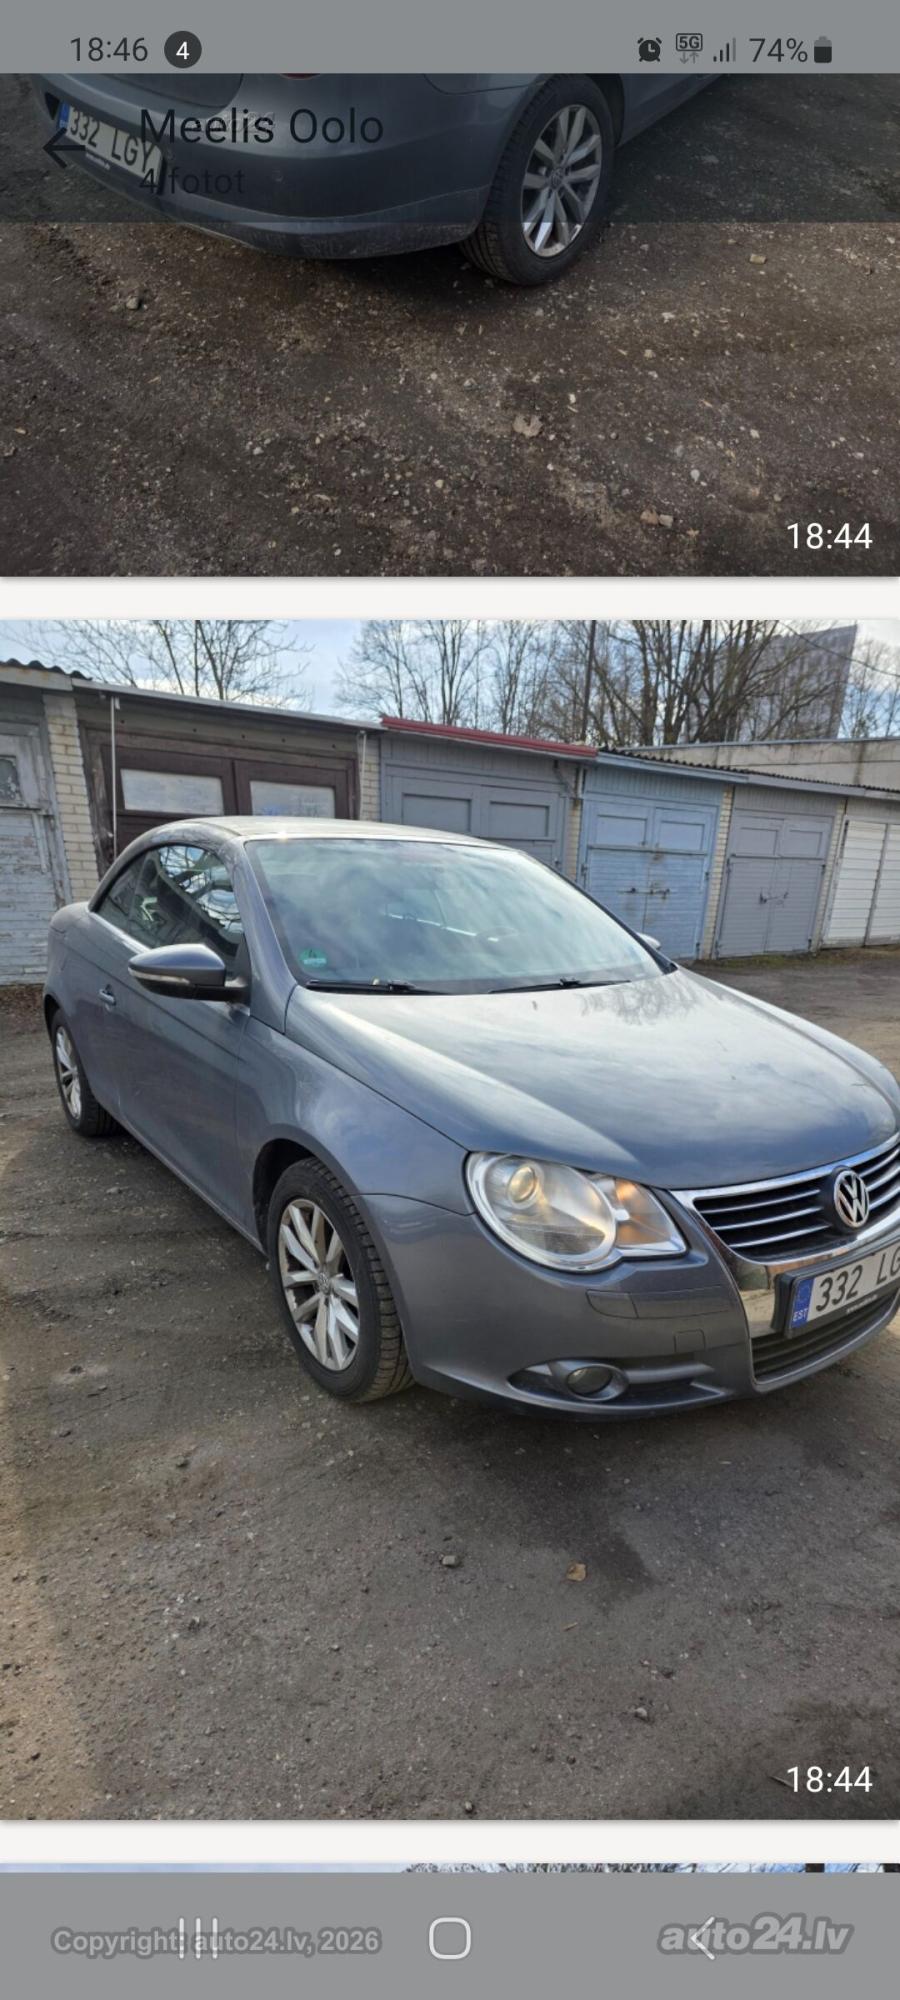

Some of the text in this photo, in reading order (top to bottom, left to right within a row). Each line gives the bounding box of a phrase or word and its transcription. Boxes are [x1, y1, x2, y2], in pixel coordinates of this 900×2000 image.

[71, 37, 148, 62] 18:46
[176, 42, 190, 60] 4
[679, 36, 700, 50] 5G
[749, 38, 808, 63] 74%
[70, 105, 100, 148] 332
[111, 128, 155, 173] LGY
[141, 107, 383, 144] Meelis Oolo
[140, 167, 245, 194] 4 fotot
[787, 522, 873, 549] 18:44
[816, 1264, 863, 1312] 332
[793, 1308, 808, 1322] EST
[787, 1766, 873, 1793] 18:44
